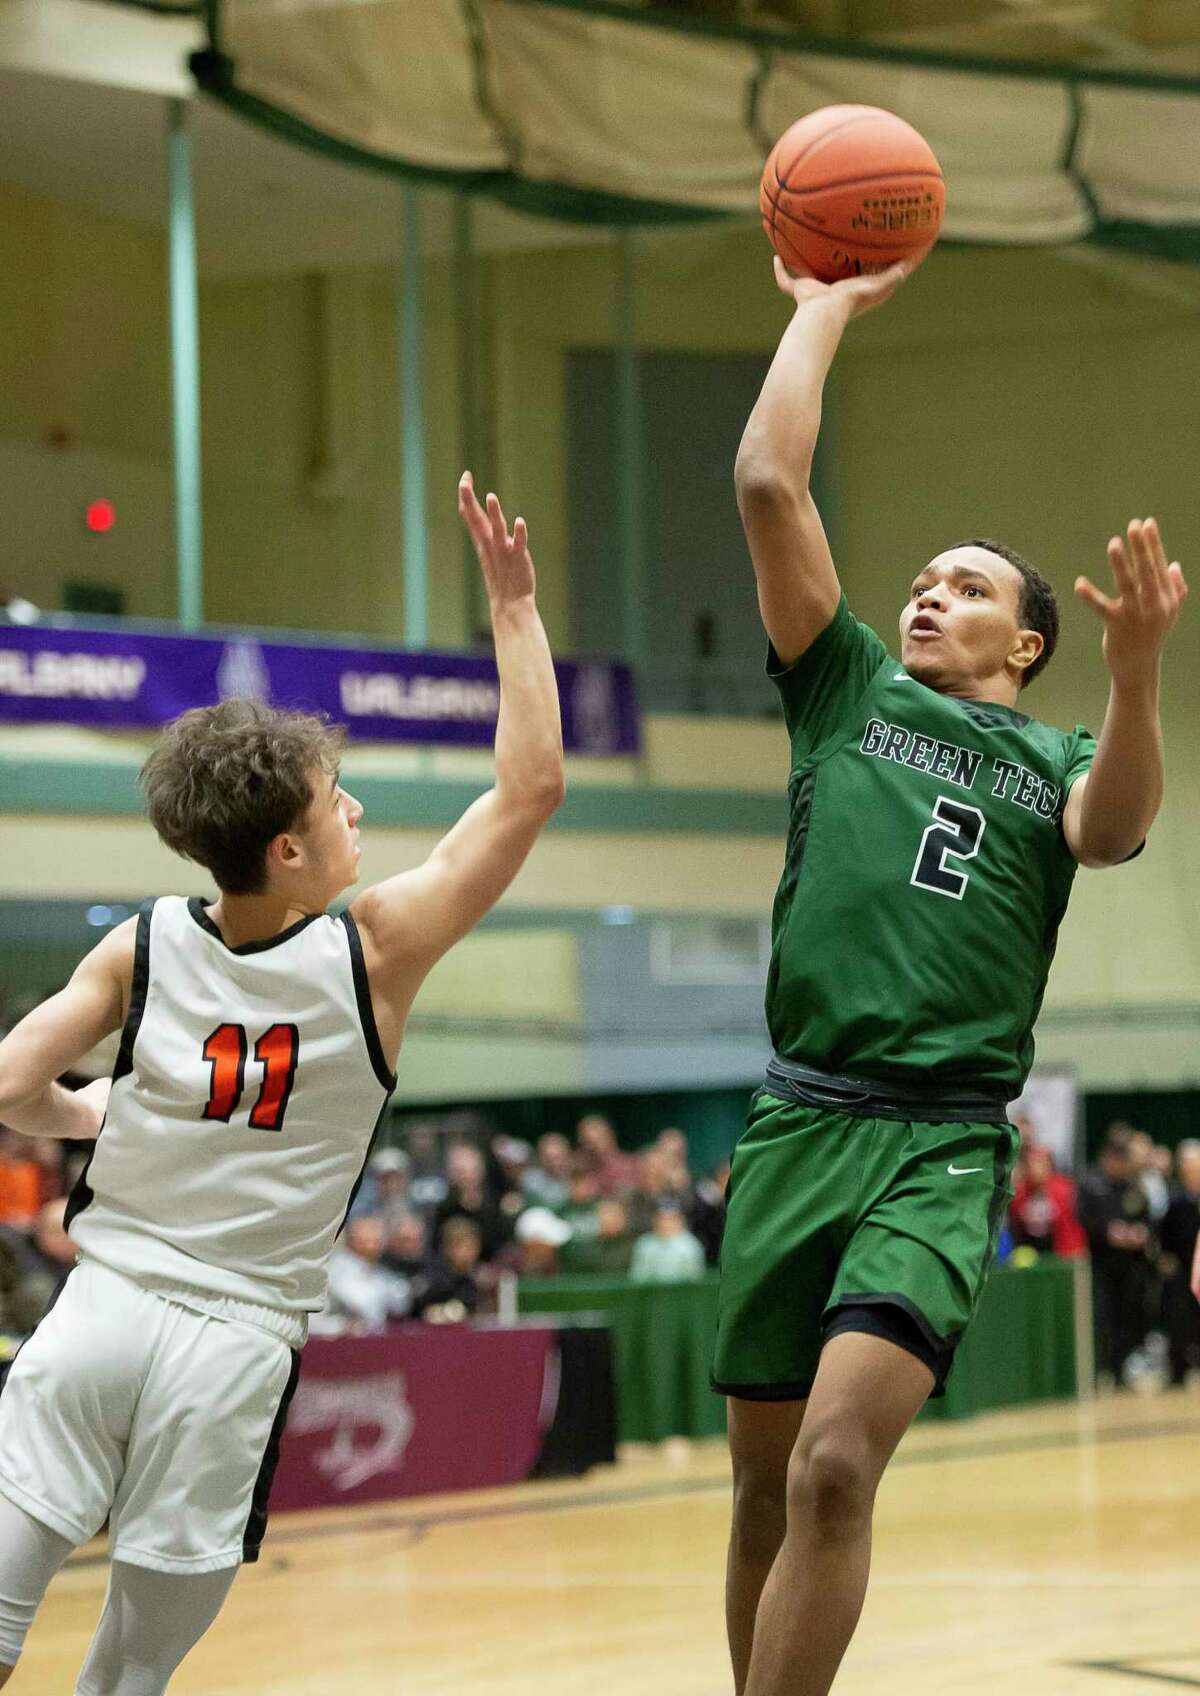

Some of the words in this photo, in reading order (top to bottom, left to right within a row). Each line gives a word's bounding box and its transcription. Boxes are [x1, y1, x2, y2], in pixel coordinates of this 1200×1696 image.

[859, 718, 983, 789] GREEN
[991, 757, 1061, 825] TEC
[910, 795, 986, 901] 2
[201, 1023, 300, 1132] 11
